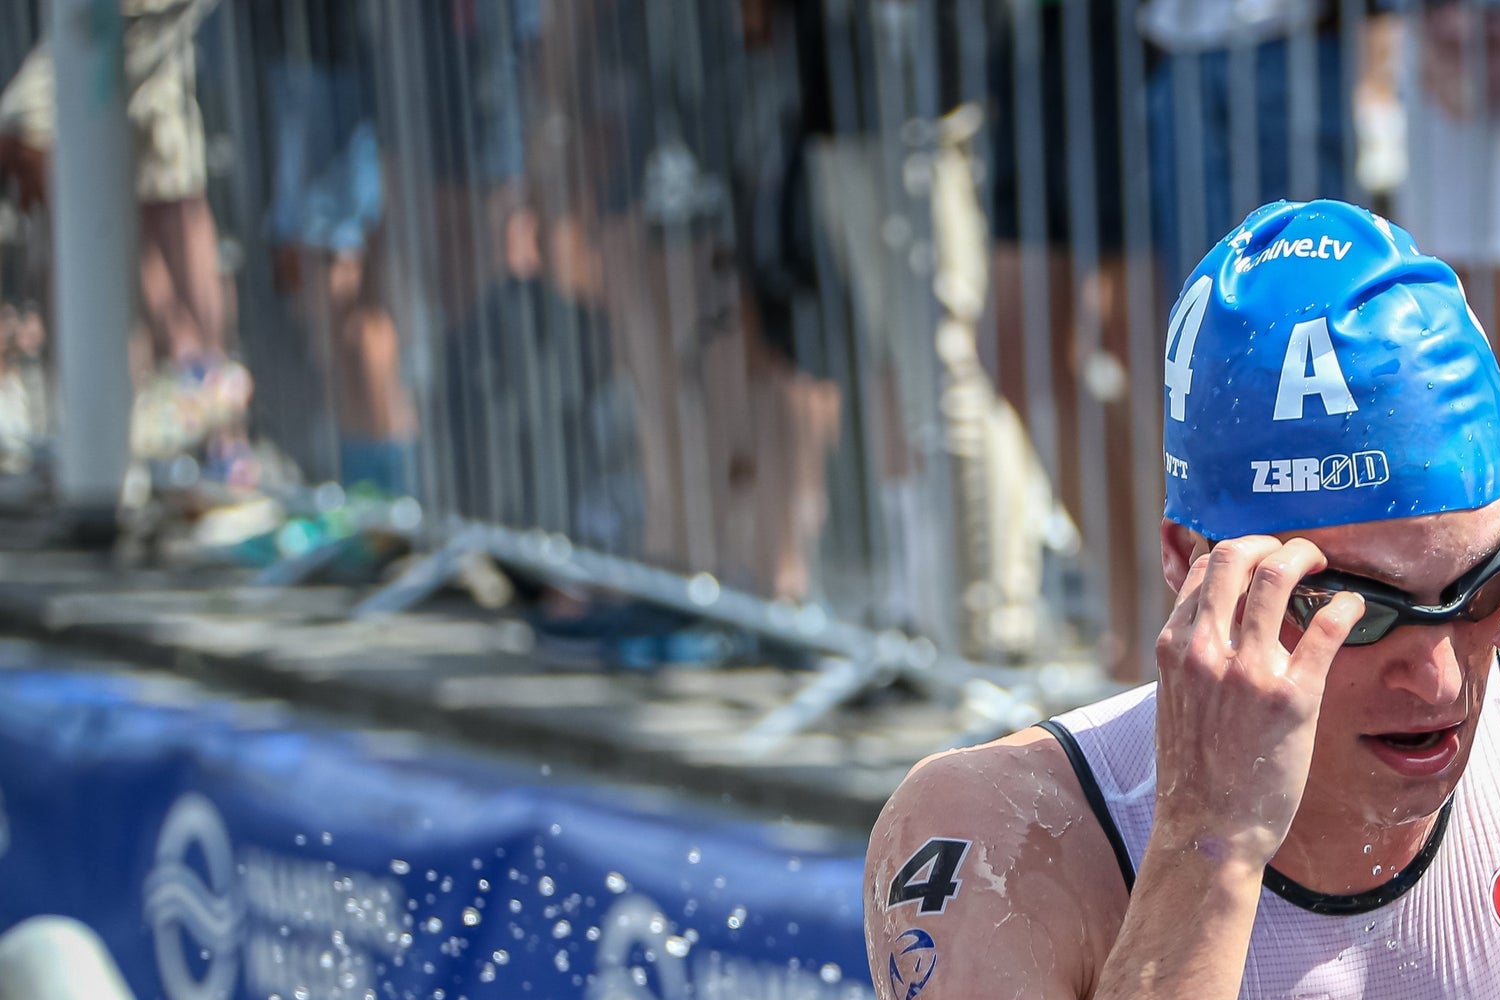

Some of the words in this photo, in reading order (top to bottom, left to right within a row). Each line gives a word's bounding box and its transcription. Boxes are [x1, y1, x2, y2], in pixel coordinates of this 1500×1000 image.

[1165, 274, 1213, 422] 4
[1273, 317, 1359, 421] A
[885, 837, 973, 917] 4
